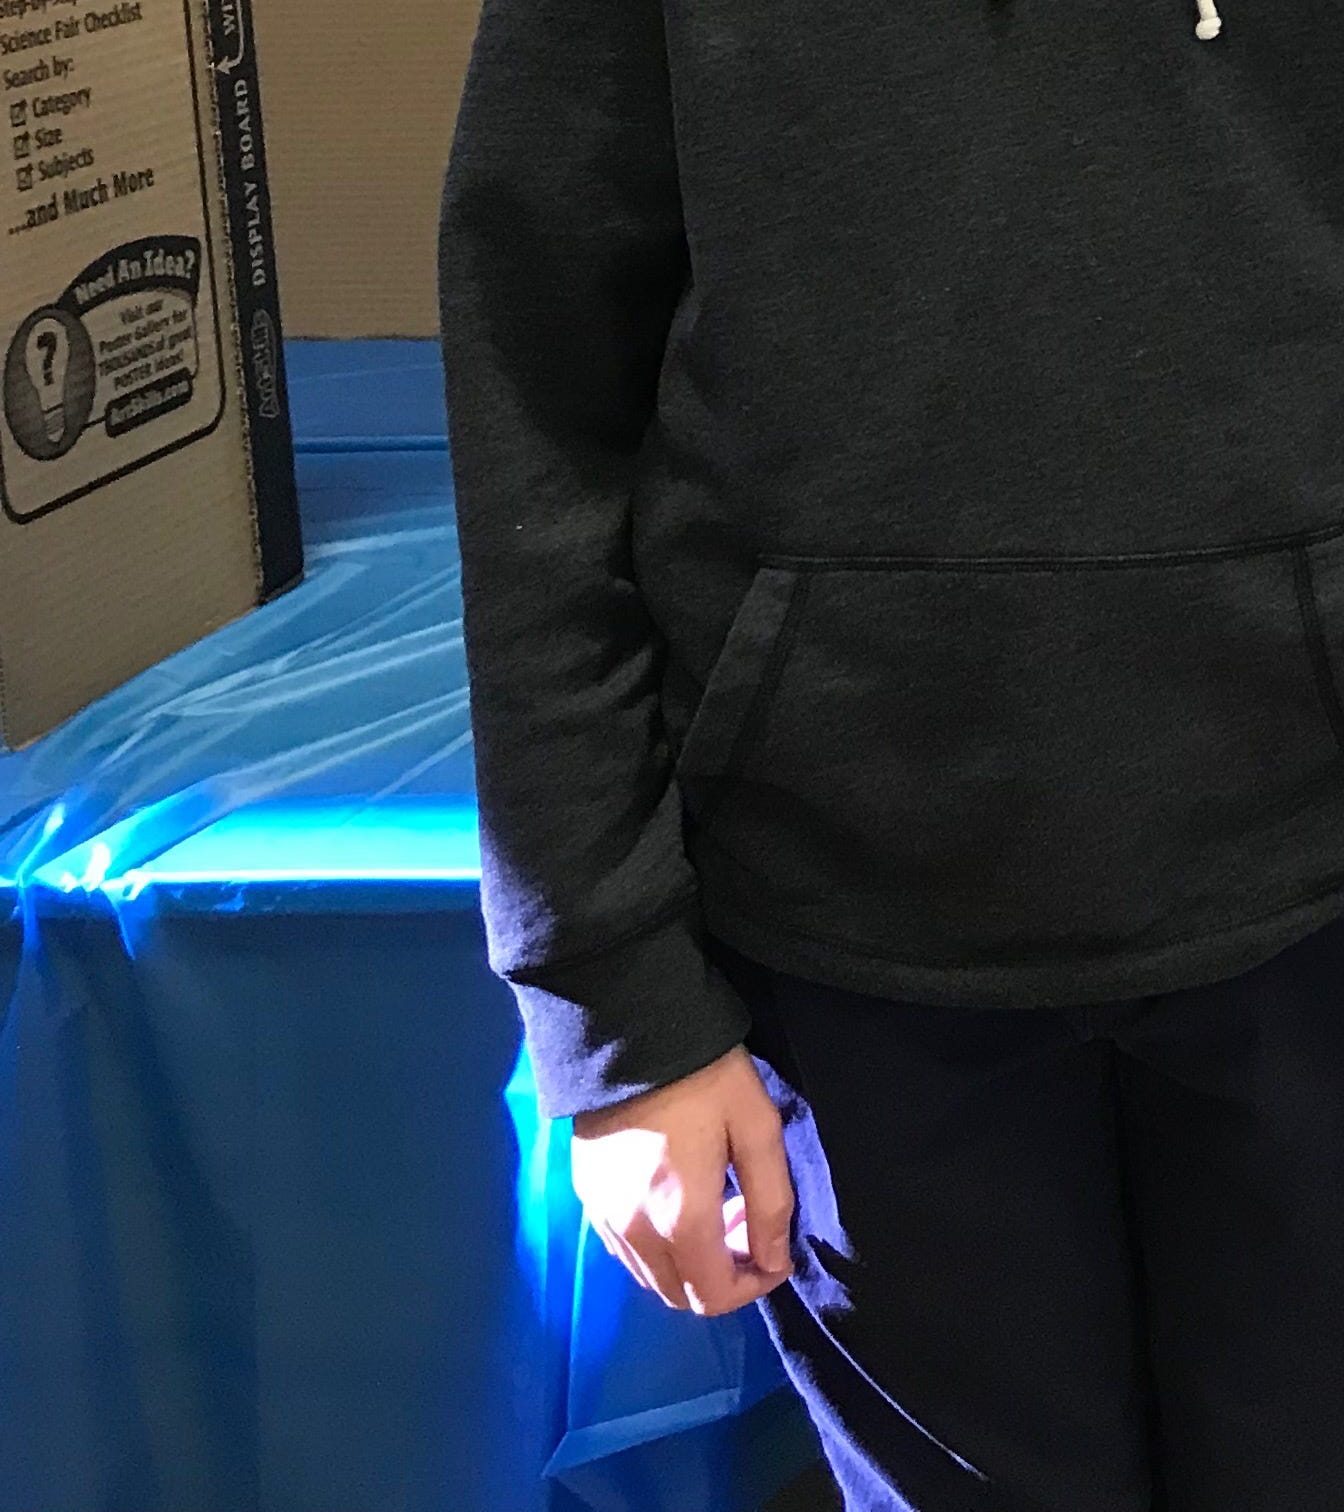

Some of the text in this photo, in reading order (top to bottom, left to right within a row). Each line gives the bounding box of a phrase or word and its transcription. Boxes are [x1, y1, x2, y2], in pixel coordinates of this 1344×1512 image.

[1, 2, 143, 56] Science Fair Checklist
[3, 55, 75, 90] Search by:
[32, 88, 92, 118] Category
[234, 79, 256, 171] BOARD
[35, 127, 62, 150] Size
[38, 147, 94, 182] Subjects
[63, 177, 109, 216] Much
[113, 168, 155, 198] More
[247, 182, 267, 287] DISPLAY
[74, 248, 195, 305] Need An Idea?
